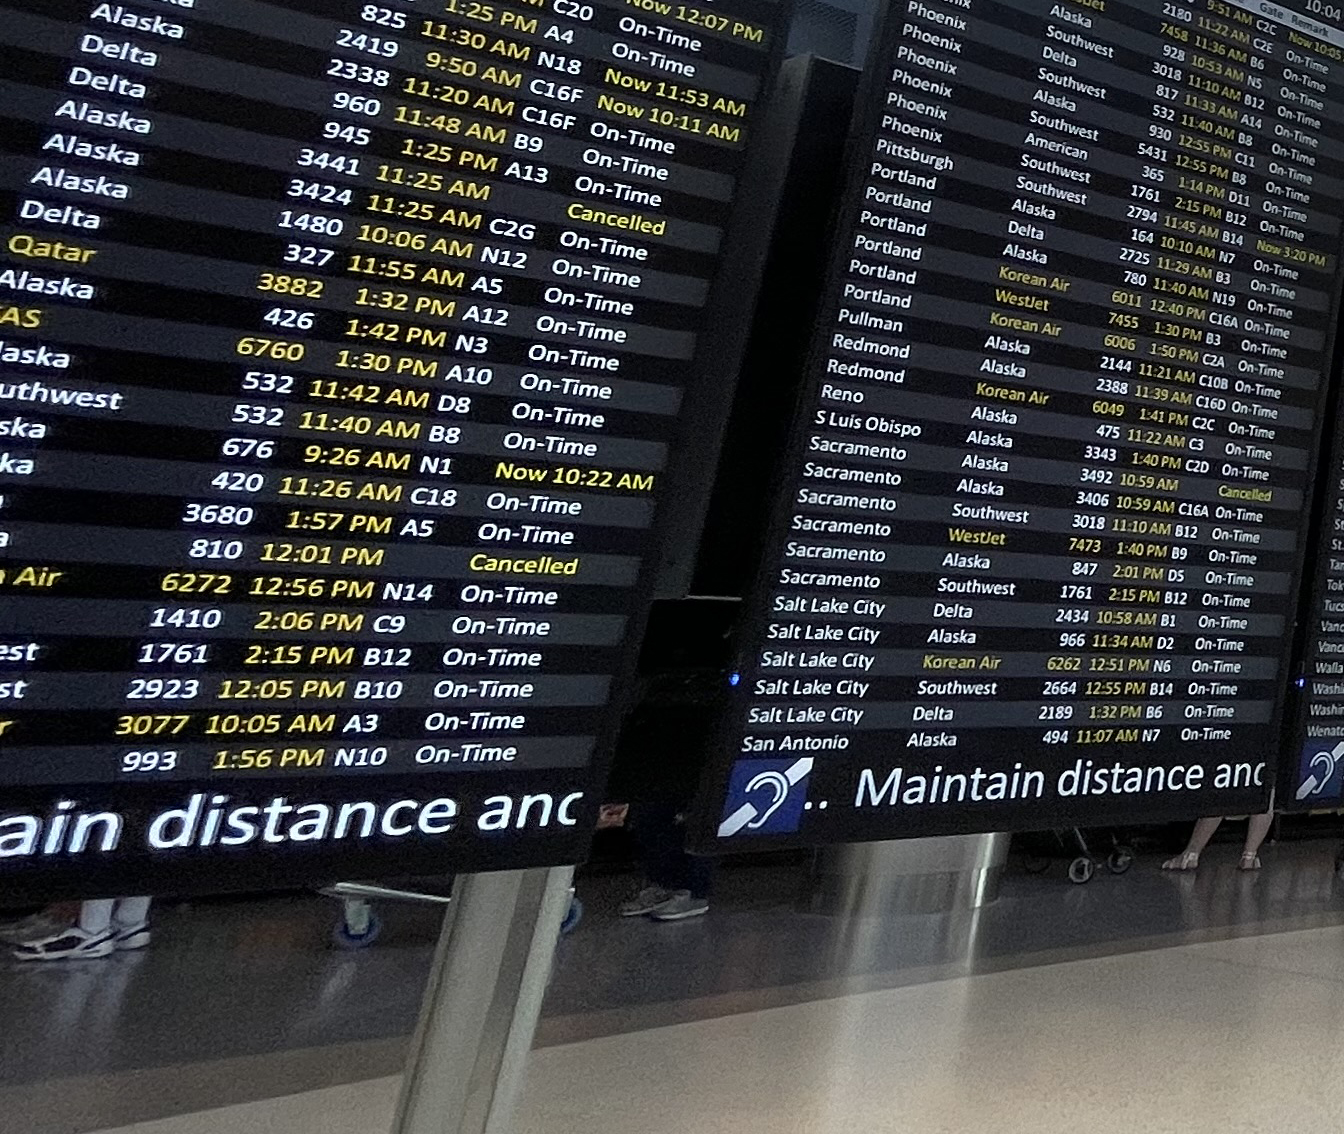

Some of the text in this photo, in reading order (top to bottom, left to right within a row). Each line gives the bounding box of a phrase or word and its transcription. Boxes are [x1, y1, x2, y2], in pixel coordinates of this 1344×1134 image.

[618, 16, 701, 51] On-Time
[1233, 10, 1252, 25] AM
[1255, 19, 1277, 35] C2C
[1259, 2, 1283, 19] Gate
[1290, 14, 1328, 38] Remark
[1045, 24, 1113, 58] Southwest
[1151, 61, 1182, 81] 3018
[1220, 86, 1241, 101] AM
[1277, 105, 1321, 129] On-Time
[7, 234, 626, 343] Qatar 3882 1:32 PM A12 On-Time
[802, 461, 1263, 522] Sacramento Alaska 3406 10:59 AM C16A On-Time
[114, 711, 525, 735] 3077 10:05 AM A3 On-Time
[740, 727, 1231, 752] San Antonio Alaska 494 11:07 AM N7 On-Time
[854, 762, 1044, 807] Maintain
[1057, 758, 1204, 796] distance
[144, 792, 460, 850] distance
